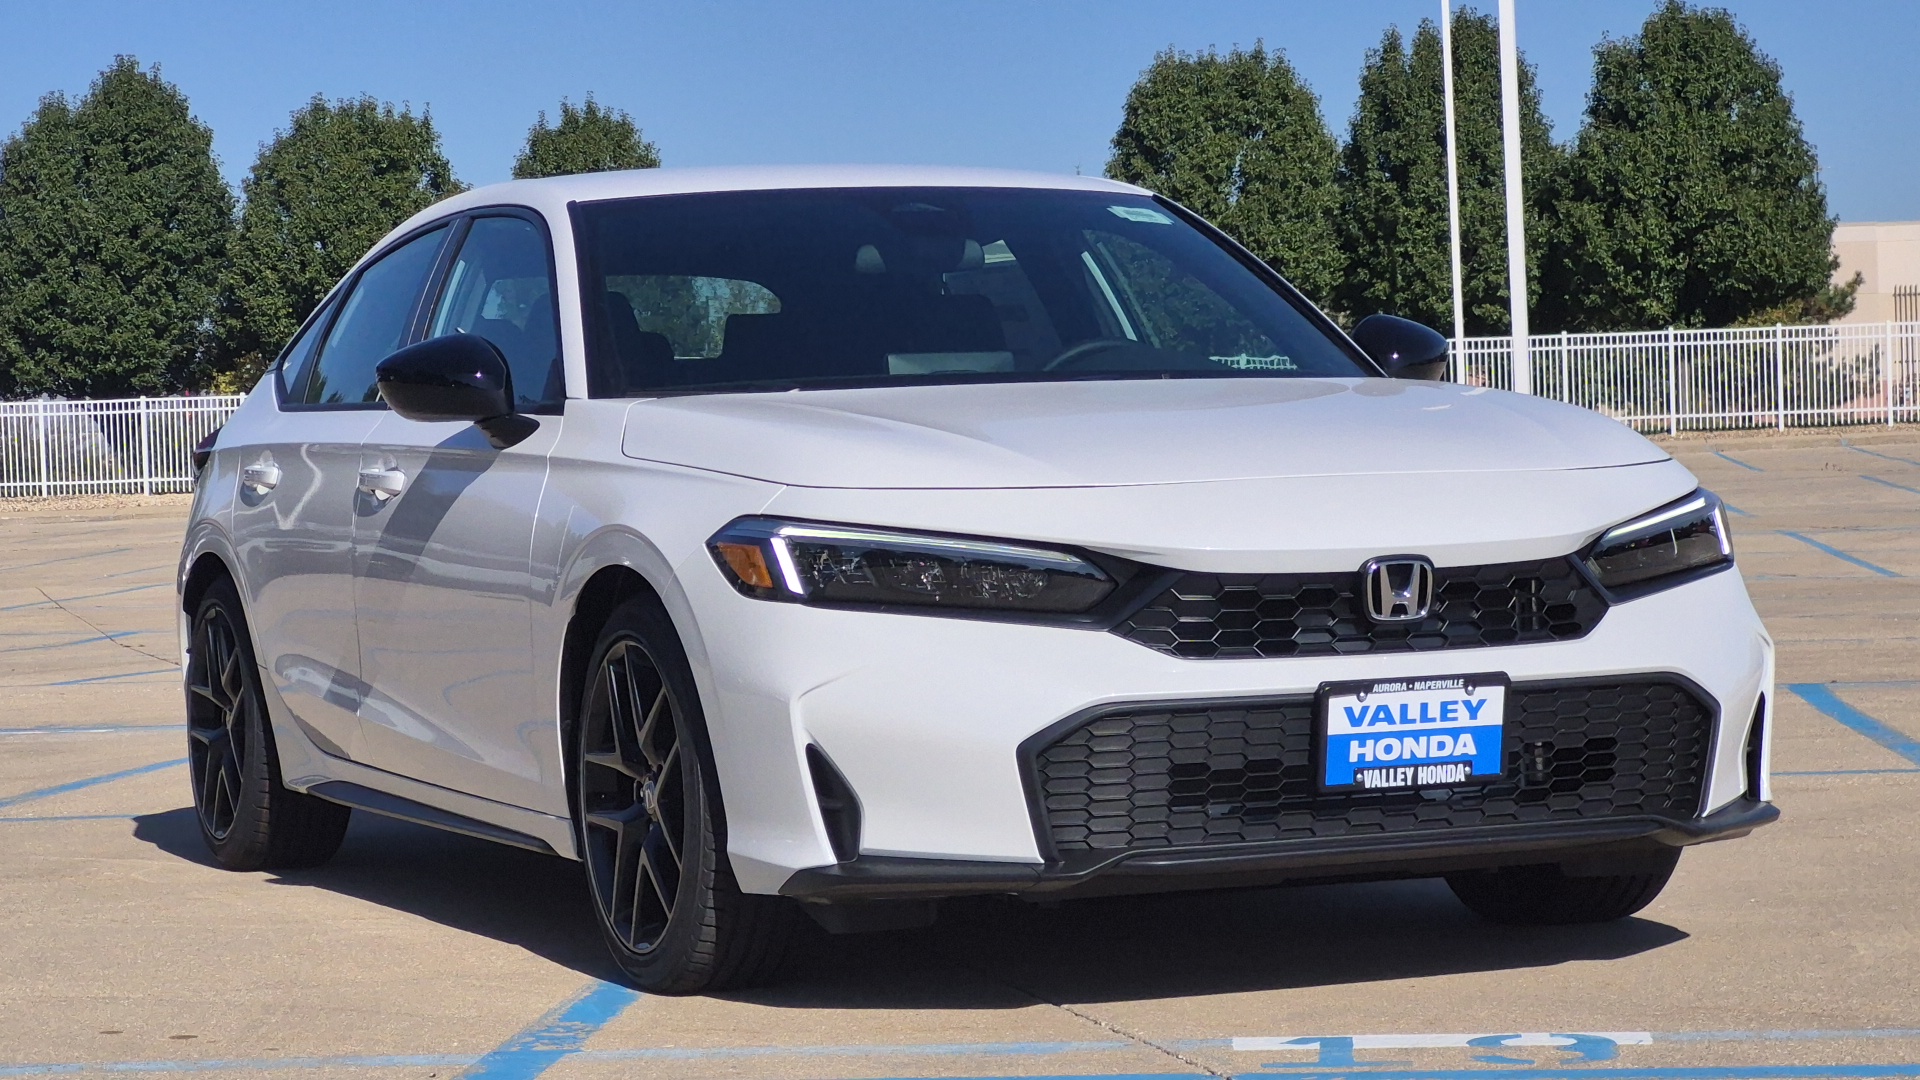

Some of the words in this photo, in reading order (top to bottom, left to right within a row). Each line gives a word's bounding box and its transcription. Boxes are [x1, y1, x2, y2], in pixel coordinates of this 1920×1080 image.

[1372, 683, 1408, 693] AURORA
[1414, 679, 1465, 691] NAPERVILLE
[1343, 698, 1488, 728] VALLEY
[1349, 733, 1477, 763] HONDA
[1363, 766, 1414, 789] VALLEY
[1417, 763, 1466, 785] HONDA
